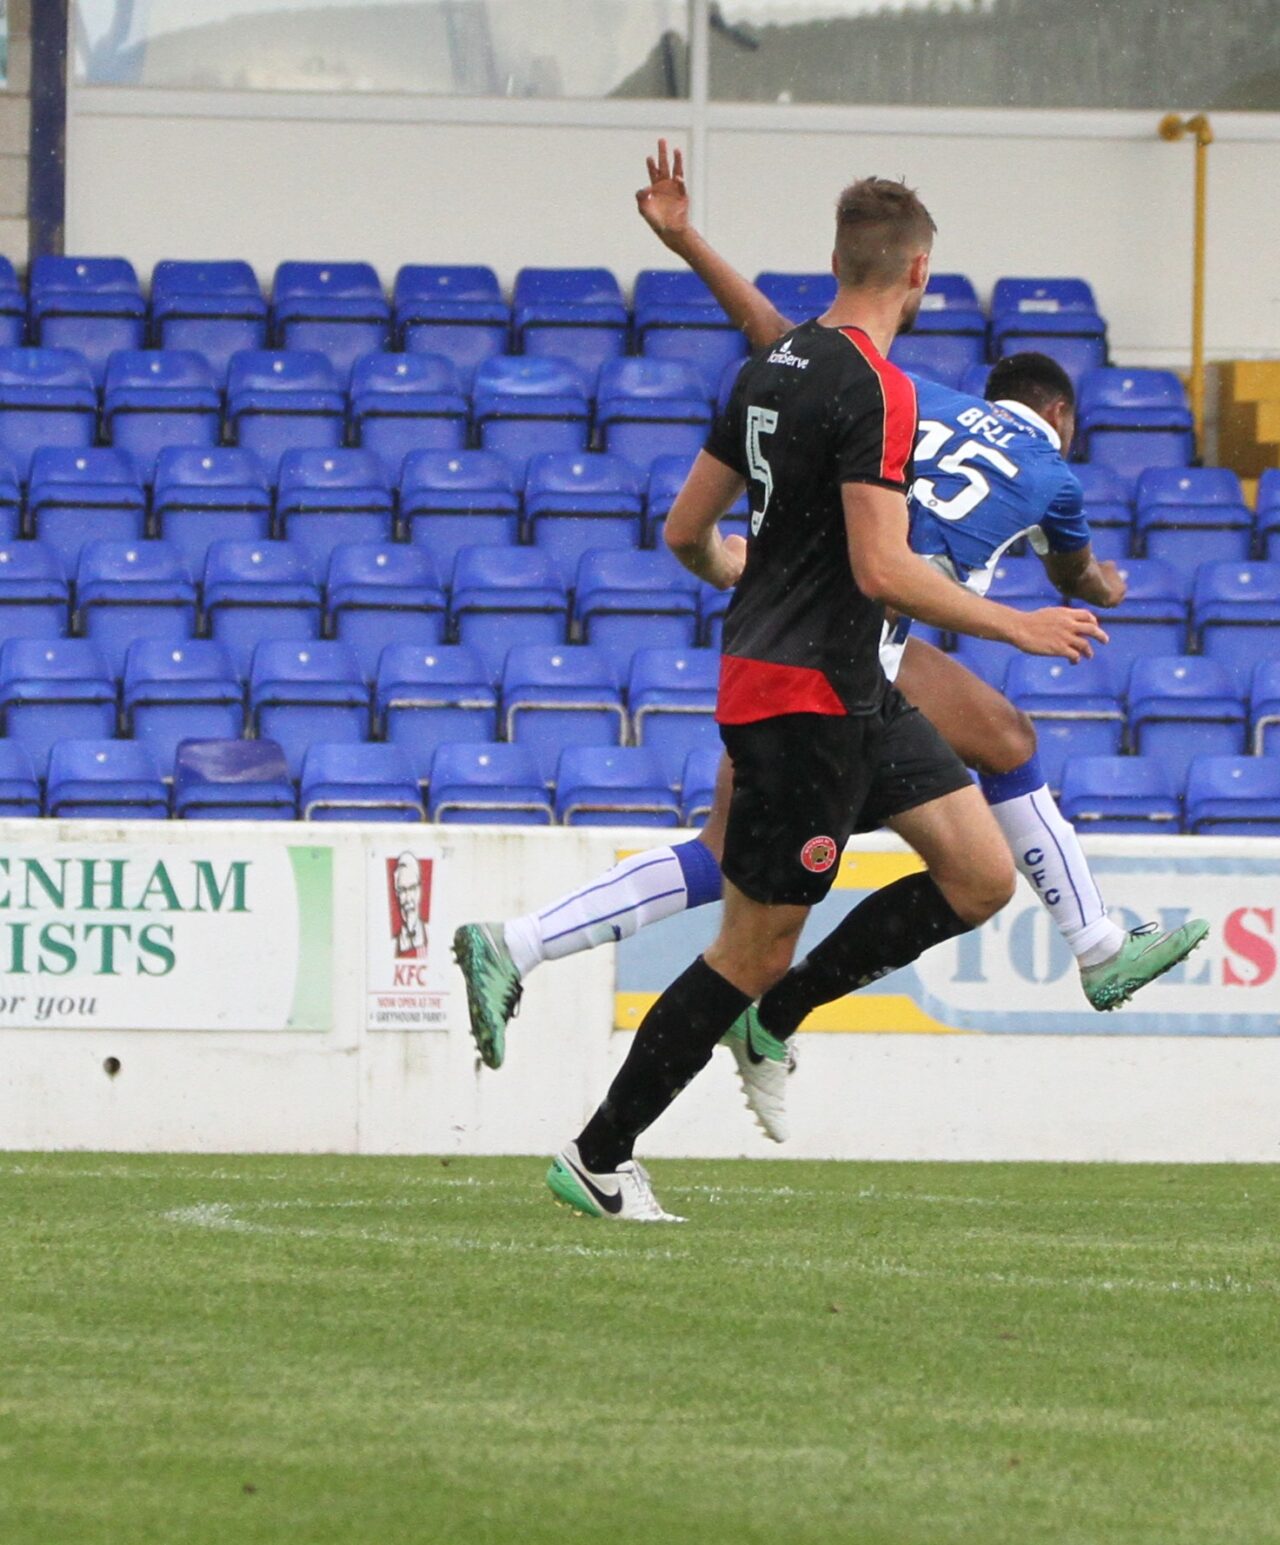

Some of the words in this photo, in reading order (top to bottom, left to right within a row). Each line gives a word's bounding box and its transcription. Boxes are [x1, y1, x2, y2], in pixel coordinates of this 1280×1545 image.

[956, 407, 1016, 449] BELL
[746, 405, 779, 537] 5
[913, 420, 1019, 521] 15
[0, 857, 253, 913] NHAM
[1023, 847, 1061, 906] CFC
[392, 964, 428, 987] KFC
[34, 995, 97, 1021] you
